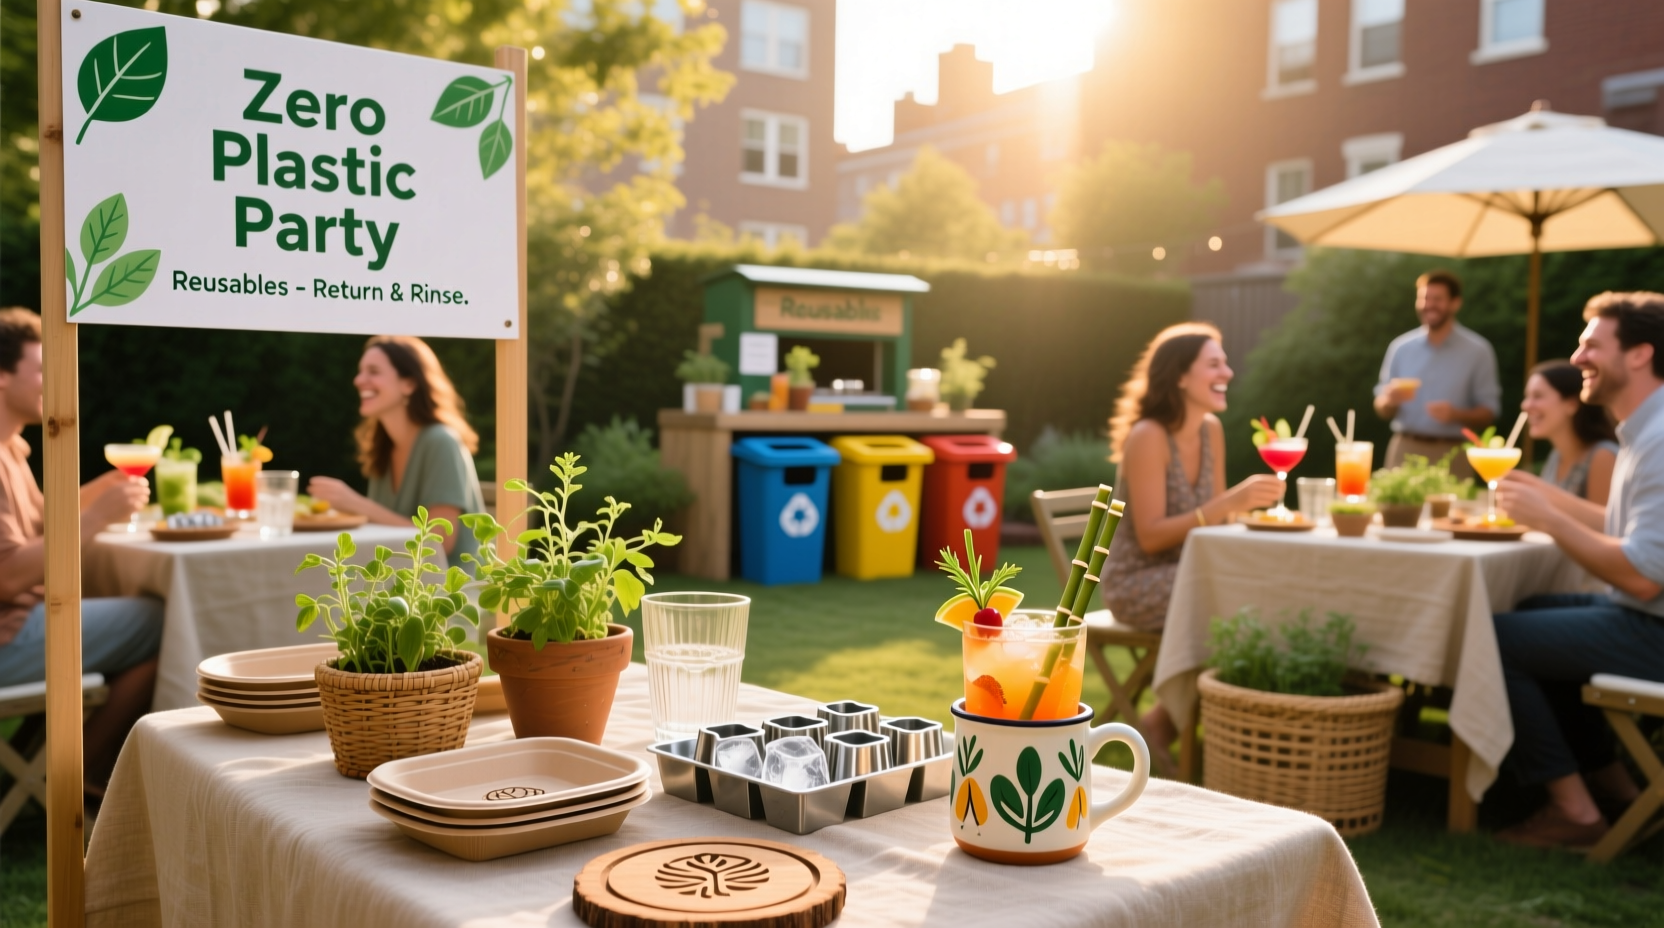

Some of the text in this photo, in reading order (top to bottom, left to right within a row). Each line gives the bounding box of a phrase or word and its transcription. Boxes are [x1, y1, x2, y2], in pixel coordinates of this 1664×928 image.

[242, 68, 386, 136] Zero
[212, 128, 417, 201] Plastic
[235, 195, 400, 272] Party
[172, 269, 289, 297] Reusables
[313, 278, 383, 302] Return
[390, 282, 404, 303] &
[411, 283, 469, 305] Rinse.
